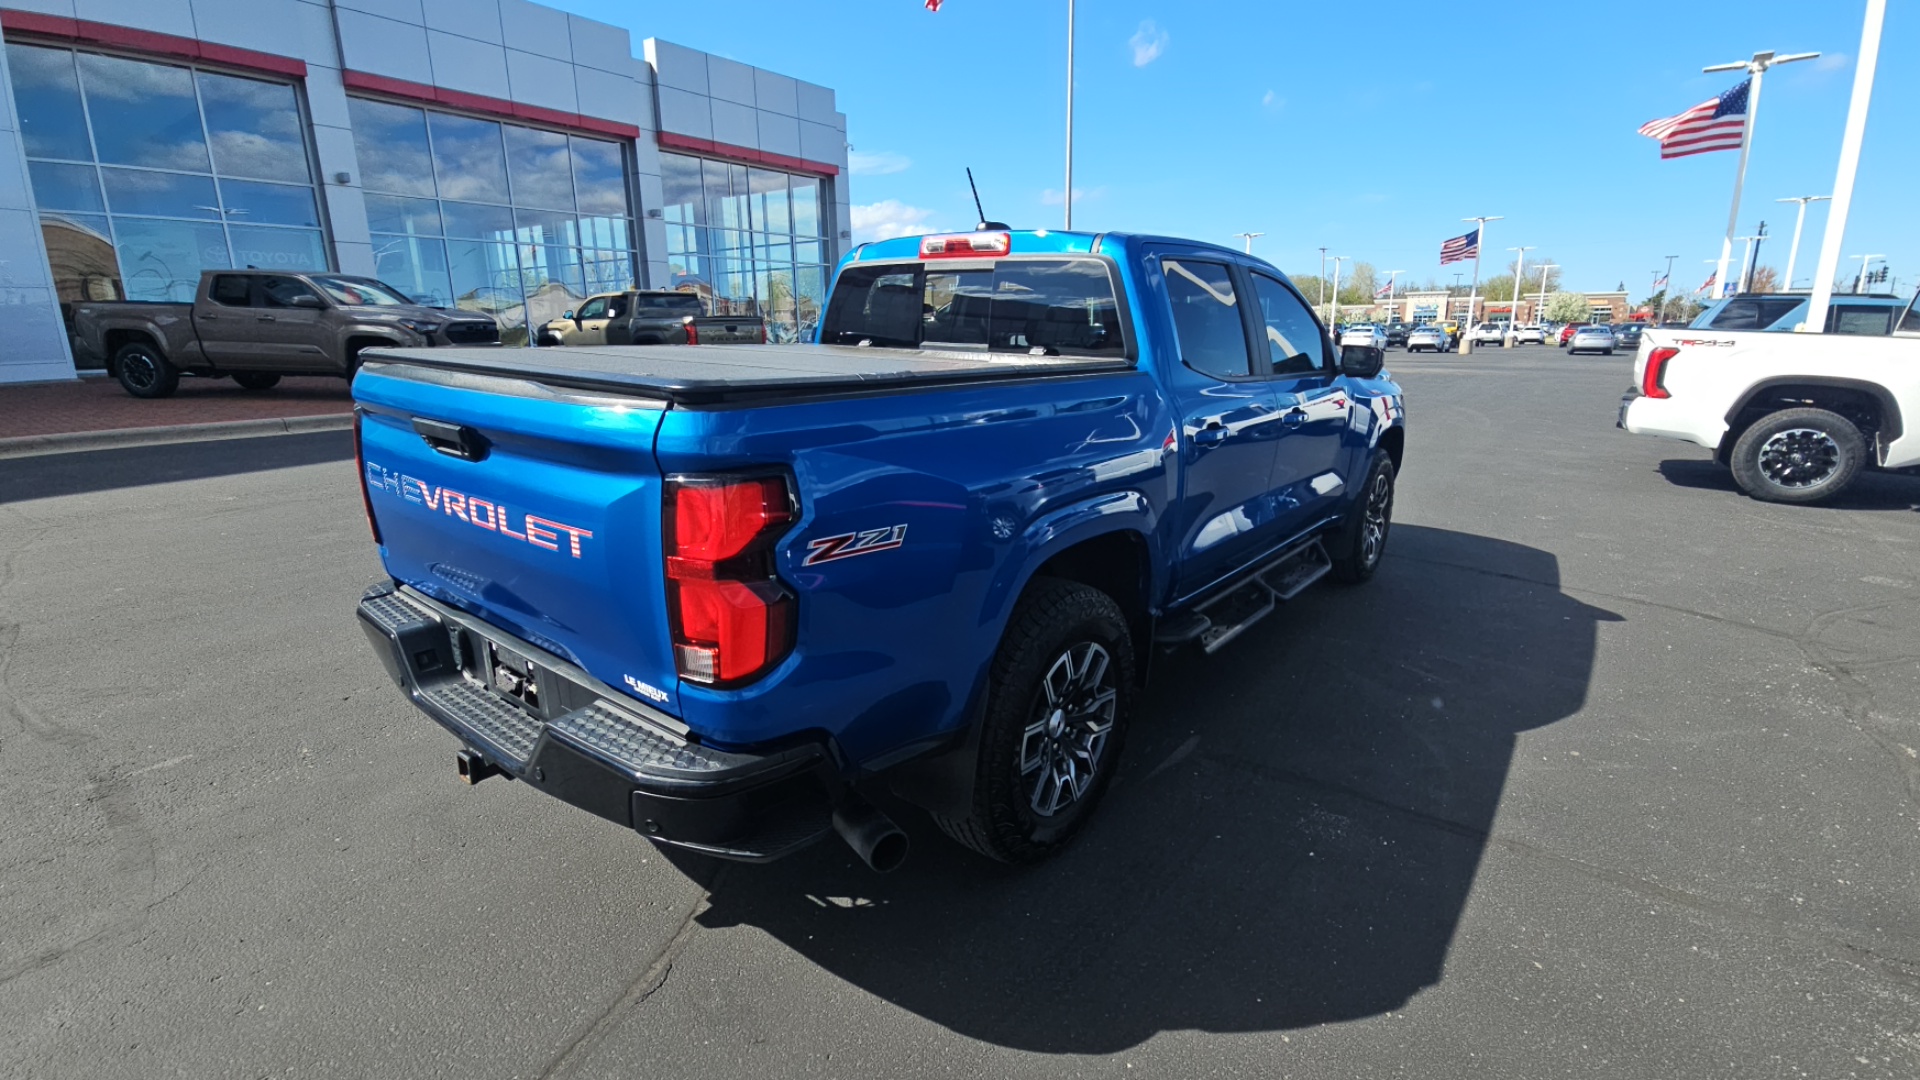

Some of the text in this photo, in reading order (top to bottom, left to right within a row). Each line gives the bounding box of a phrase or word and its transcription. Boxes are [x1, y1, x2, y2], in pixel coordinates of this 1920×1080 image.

[237, 250, 311, 265] TOYOTA
[366, 461, 593, 559] CHEVROLET
[802, 523, 908, 567] Z71
[624, 673, 636, 687] LE
